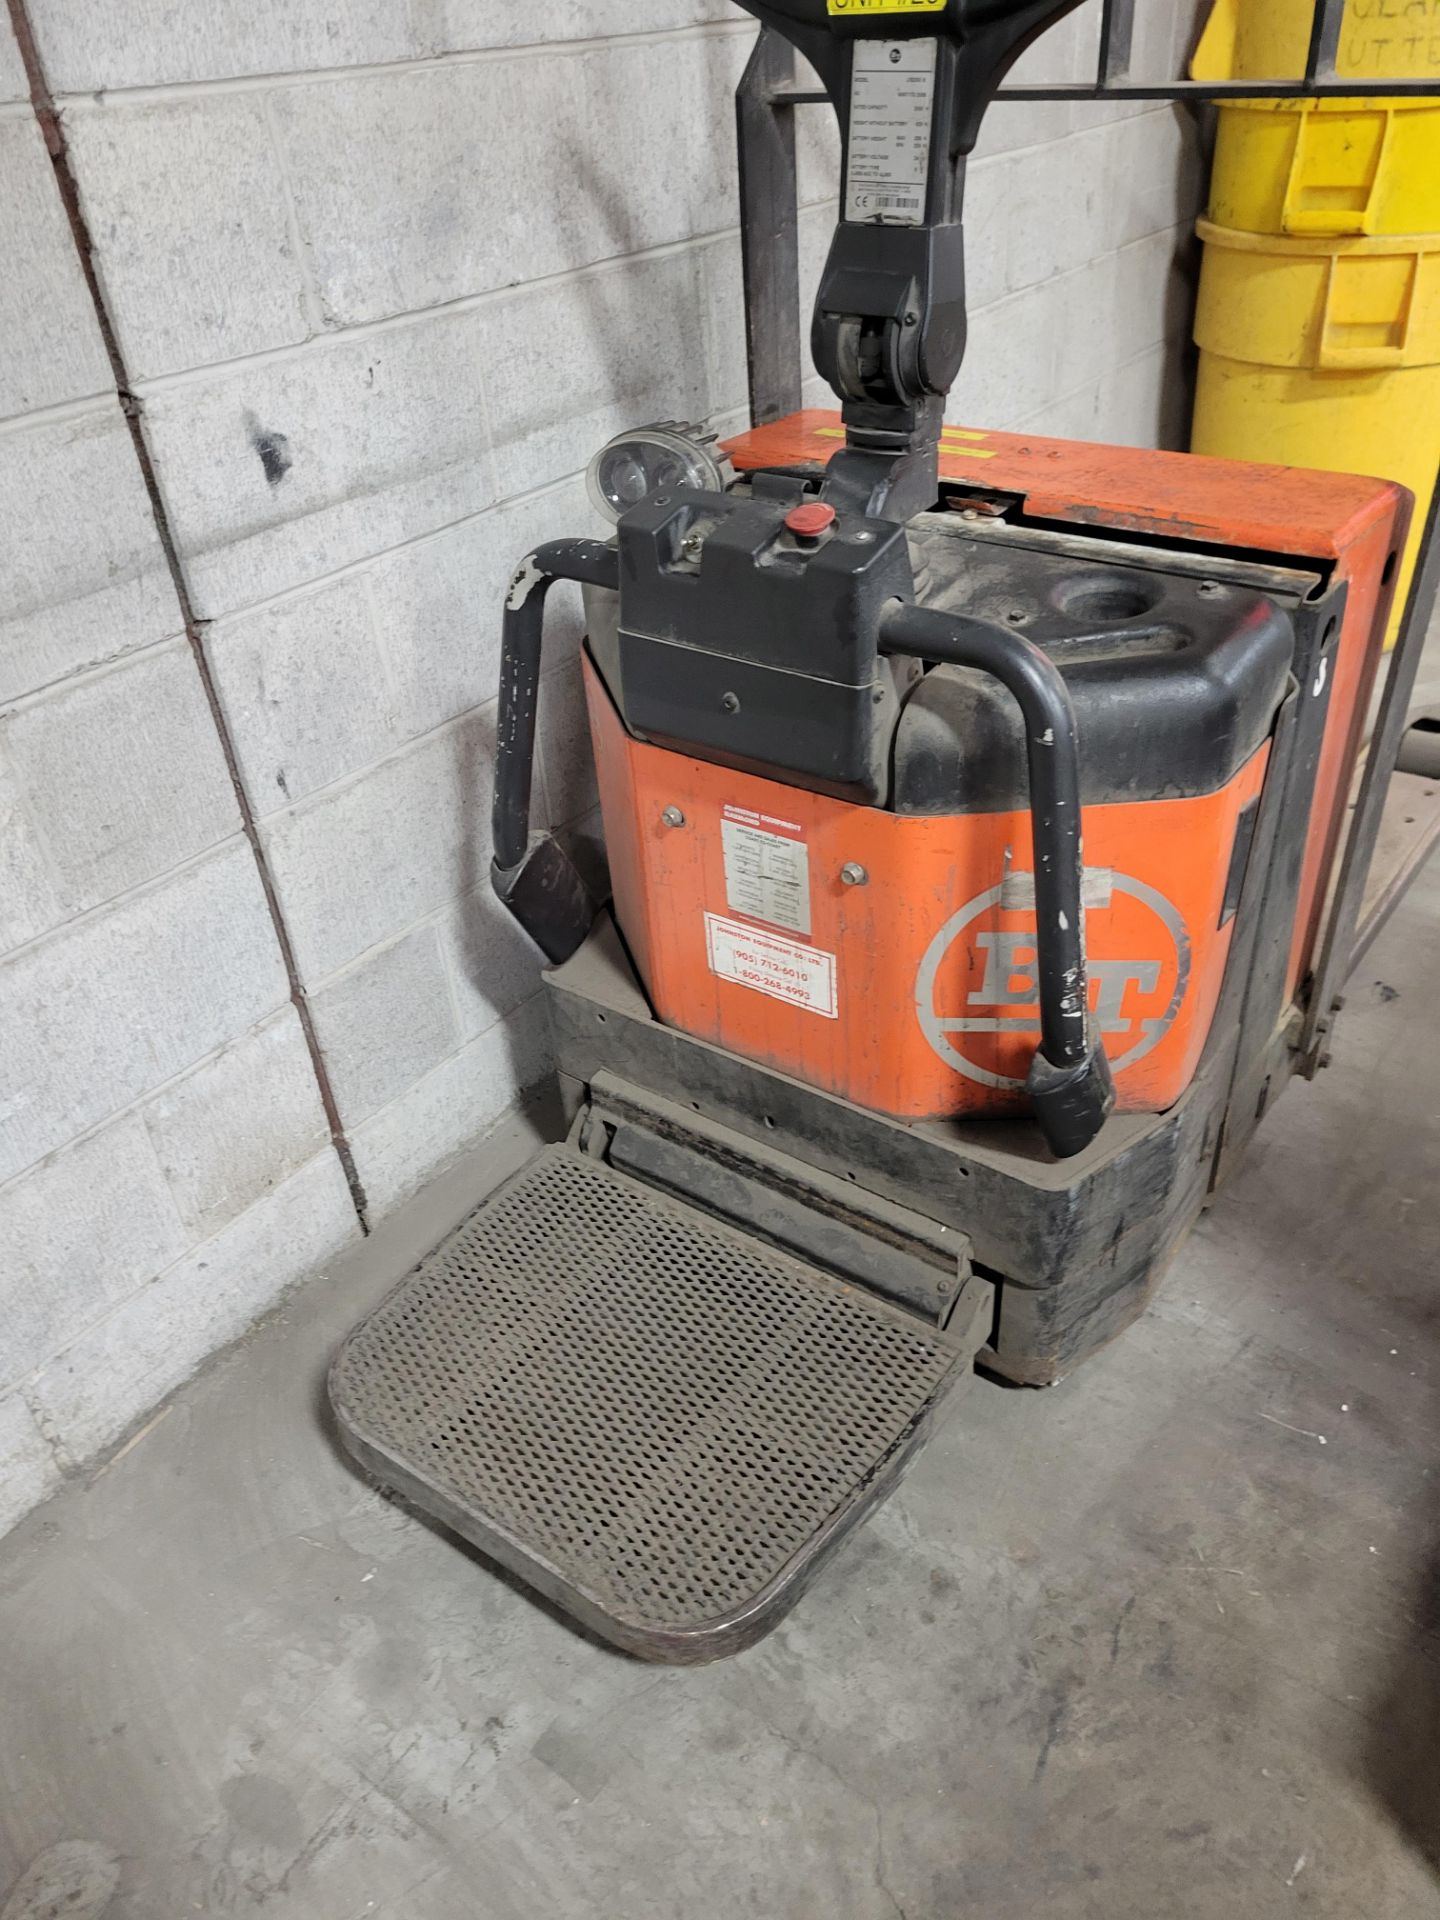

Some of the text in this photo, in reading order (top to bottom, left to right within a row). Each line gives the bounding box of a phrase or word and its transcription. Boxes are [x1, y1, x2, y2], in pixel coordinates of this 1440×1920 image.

[717, 926, 751, 942] JOHNSTON
[753, 938, 791, 956] EQUIPMENT
[733, 948, 758, 966] (905)
[760, 959, 809, 982] 712-6010
[733, 966, 811, 1000] 1-800-268-4993
